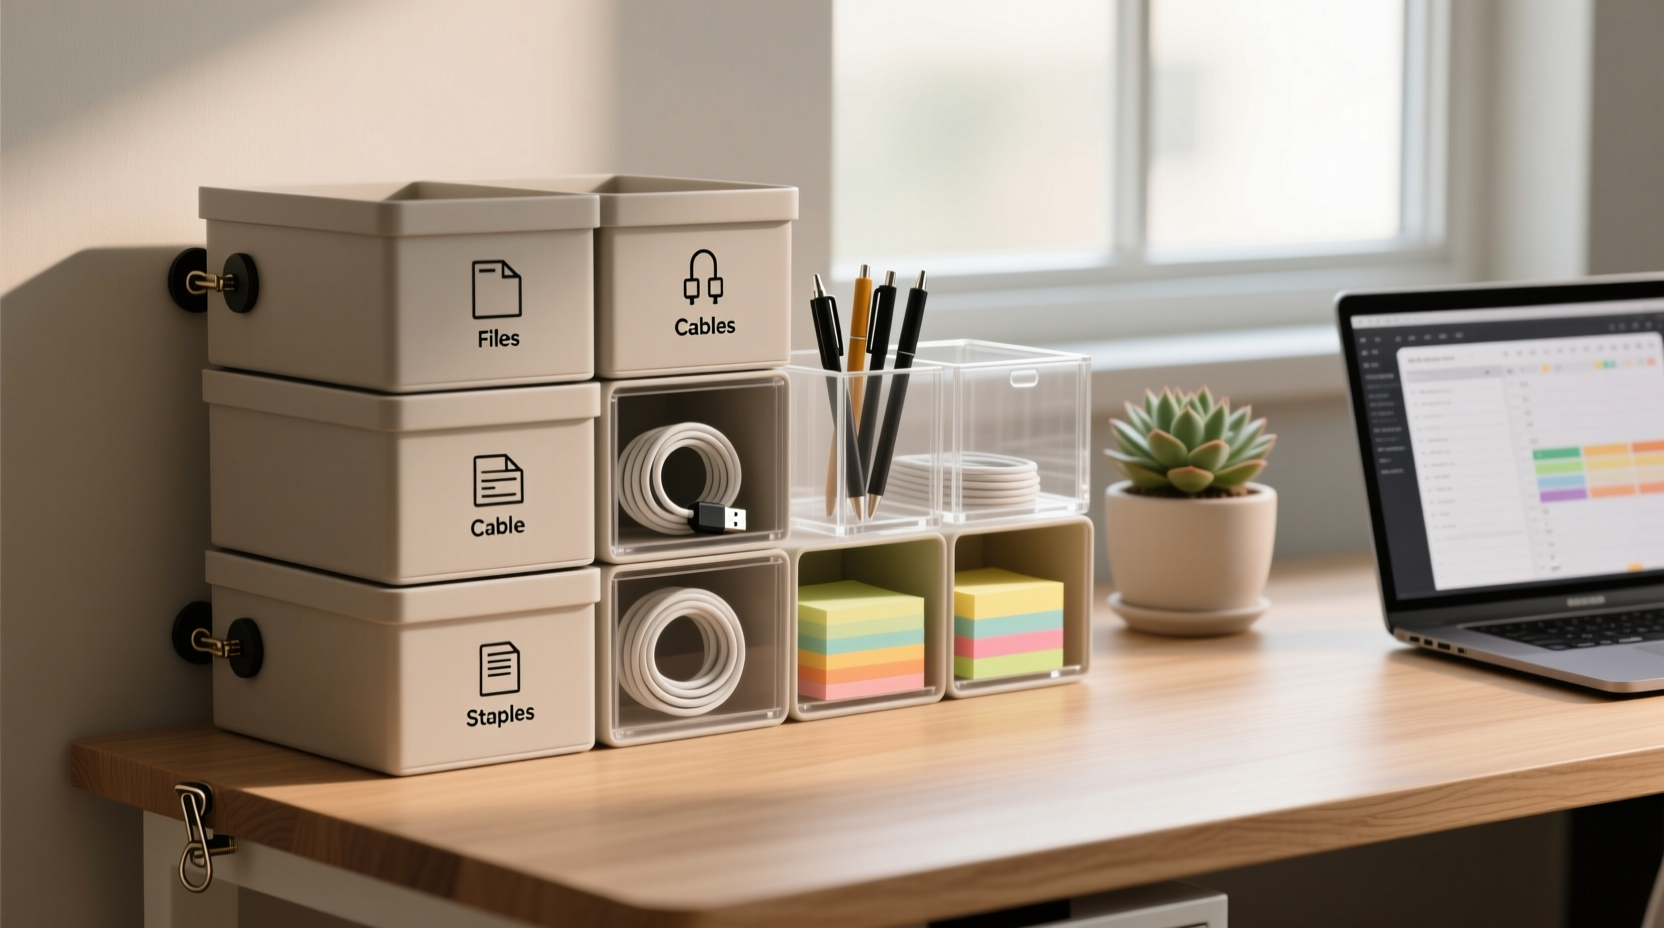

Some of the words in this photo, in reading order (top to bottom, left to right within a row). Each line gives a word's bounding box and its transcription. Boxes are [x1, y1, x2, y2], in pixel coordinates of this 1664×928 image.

[674, 316, 736, 337] Cables
[478, 328, 520, 348] Files
[470, 515, 526, 538] Cable
[466, 704, 535, 728] Staples
